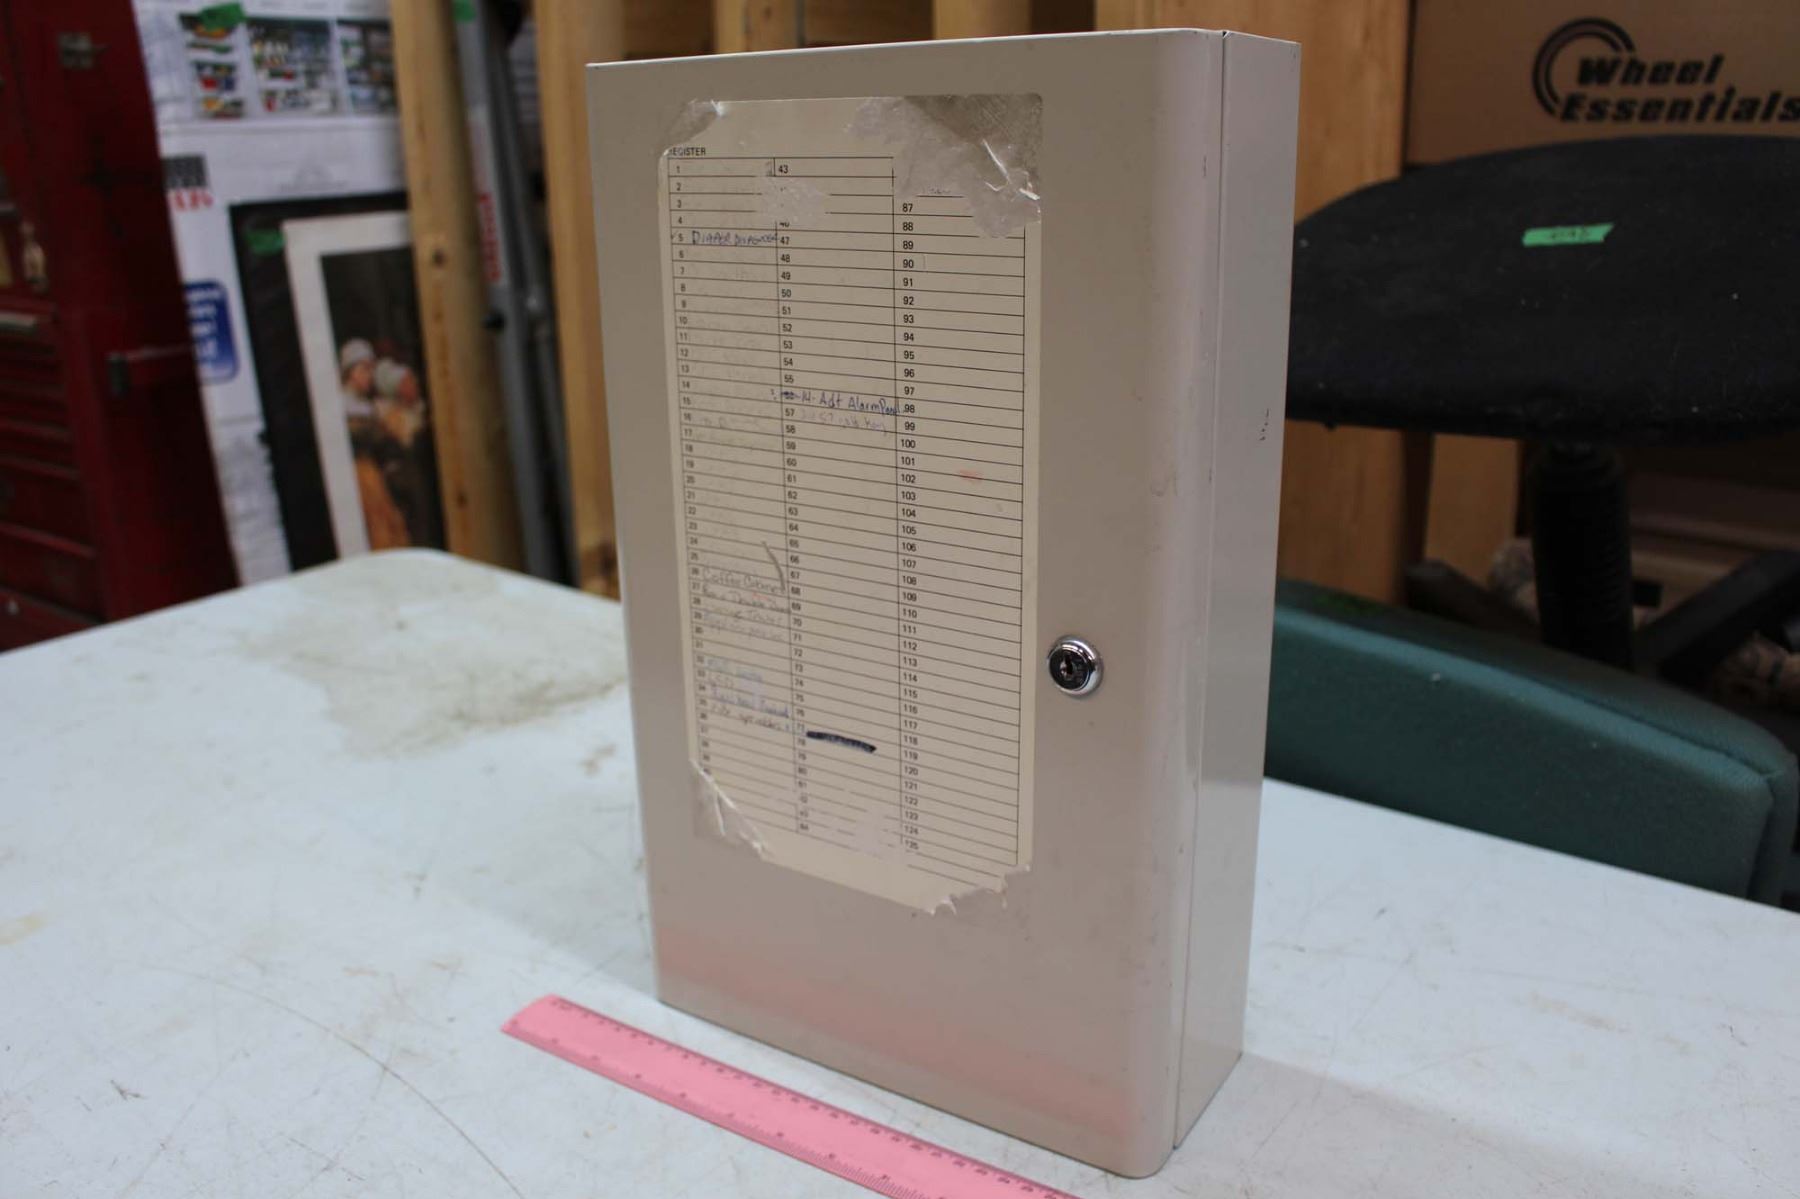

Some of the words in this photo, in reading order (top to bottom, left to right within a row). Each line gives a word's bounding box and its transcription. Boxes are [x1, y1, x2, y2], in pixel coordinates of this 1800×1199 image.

[1577, 53, 1724, 86] Wheel
[1560, 86, 1800, 122] Essentials
[676, 165, 680, 174] 1
[778, 165, 789, 174] 43
[676, 183, 681, 192] 2
[677, 200, 682, 209] 3
[902, 203, 913, 213] 87
[678, 216, 683, 225] 4
[902, 221, 913, 231] 88
[678, 233, 684, 242] 5
[780, 236, 790, 245] 47
[902, 240, 914, 250] 89
[679, 250, 684, 259] 6
[780, 254, 790, 263] 48
[903, 259, 914, 269] 90
[680, 266, 685, 275] 7
[781, 271, 791, 280] 49
[903, 278, 913, 287] 91
[680, 283, 686, 292] 8
[781, 289, 792, 297] 50
[681, 300, 686, 309] 9
[903, 296, 914, 305] 92
[782, 306, 791, 315] 51
[679, 316, 688, 325] 10
[903, 314, 914, 324] 93
[782, 324, 792, 333] 52
[680, 332, 688, 341] 11
[904, 332, 914, 342] 94
[783, 341, 793, 350] 53
[680, 349, 689, 358] 12
[904, 350, 915, 360] 95
[783, 358, 793, 366] 54
[681, 365, 689, 373] 13
[904, 368, 915, 378] 96
[784, 375, 794, 384] 55
[682, 380, 690, 389] 14
[904, 386, 915, 395] 97
[683, 397, 691, 406] 15
[785, 408, 795, 417] 57
[904, 404, 915, 414] 98
[683, 412, 692, 421] 16
[785, 425, 796, 434] 58
[904, 422, 915, 431] 99
[684, 428, 693, 437] 17
[685, 444, 693, 453] 18
[786, 441, 796, 450] 59
[901, 439, 916, 449] 100
[686, 460, 694, 468] 19
[787, 458, 797, 467] 60
[901, 456, 915, 466] 101
[686, 475, 695, 484] 20
[787, 474, 797, 483] 61
[901, 474, 916, 484] 102
[687, 491, 695, 500] 21
[787, 491, 798, 500] 62
[901, 491, 916, 501] 103
[688, 506, 697, 515] 22
[788, 507, 798, 515] 63
[902, 508, 916, 518] 104
[789, 523, 799, 532] 64
[901, 525, 917, 535] 105
[789, 539, 799, 548] 65
[902, 542, 917, 552] 106
[790, 555, 799, 564] 66
[902, 559, 917, 569] 107
[790, 570, 800, 579] 67
[902, 575, 917, 585] 108
[791, 586, 800, 595] 68
[902, 592, 917, 602] 109
[792, 602, 801, 610] 69
[902, 608, 917, 618] 110
[793, 618, 802, 627] 70
[903, 624, 917, 634] 111
[793, 633, 802, 641] 71
[903, 640, 918, 650] 112
[903, 656, 918, 667] 113
[903, 672, 918, 682] 114
[903, 688, 918, 698] 115
[904, 704, 918, 714] 116
[904, 720, 918, 730] 117
[904, 735, 918, 745] 118
[904, 750, 918, 760] 119
[904, 766, 918, 776] 120
[904, 781, 918, 791] 121
[905, 796, 918, 806] 122
[905, 811, 919, 821] 123
[905, 825, 919, 835] 124
[905, 840, 919, 850] 125
